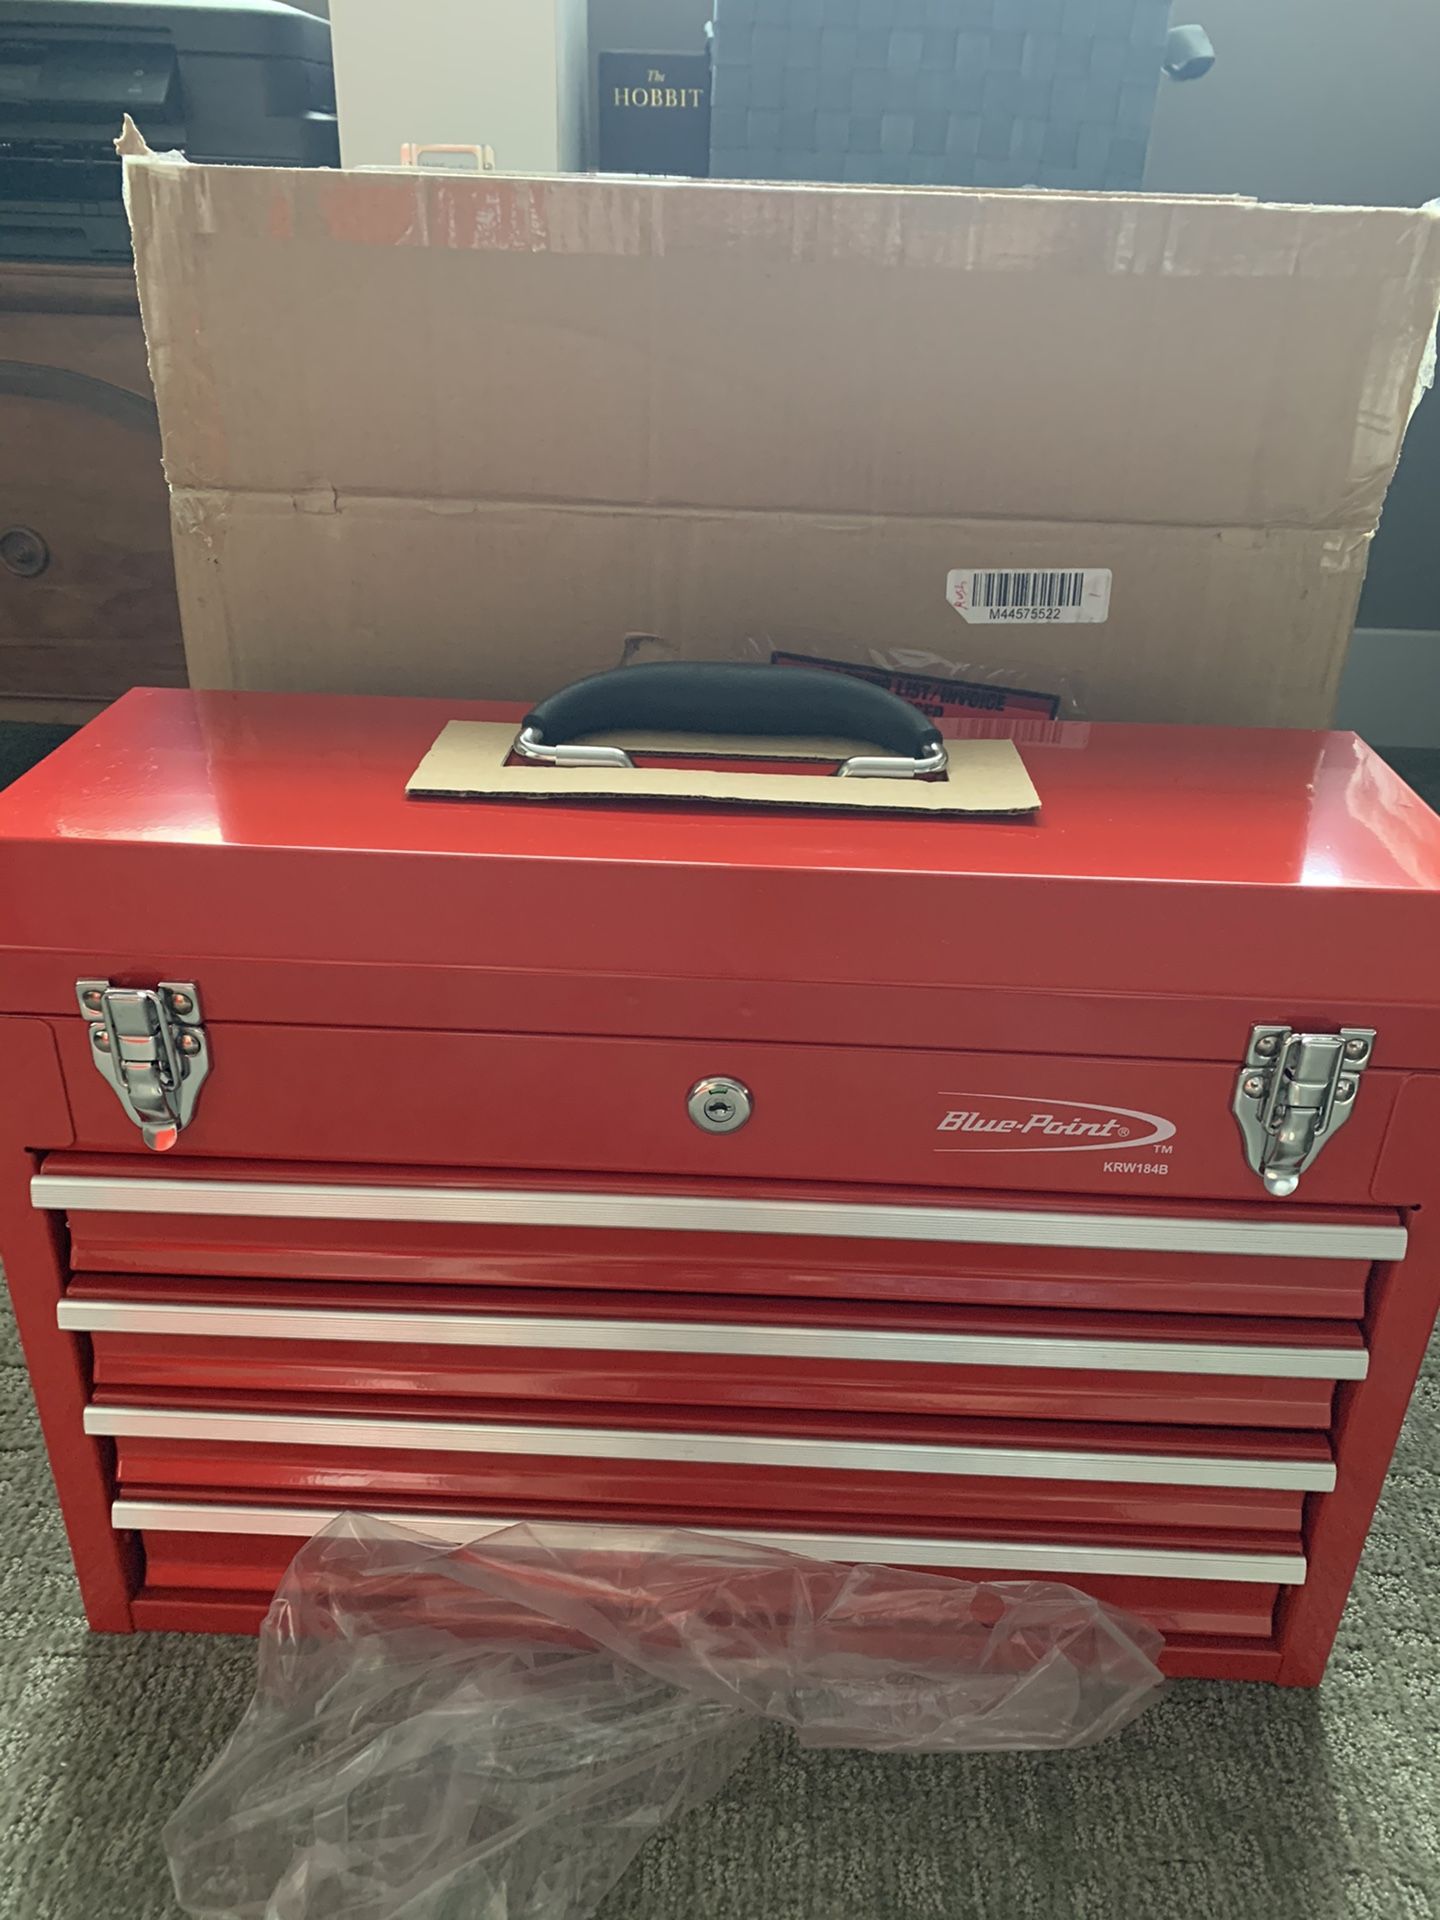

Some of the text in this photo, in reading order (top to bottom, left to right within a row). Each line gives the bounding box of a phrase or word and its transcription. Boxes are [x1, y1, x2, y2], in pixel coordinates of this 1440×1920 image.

[647, 68, 666, 82] The
[613, 86, 704, 108] HOBBIT
[988, 607, 1061, 620] M44575522
[1153, 1144, 1173, 1154] TM
[1103, 1161, 1169, 1175] KRW184B
